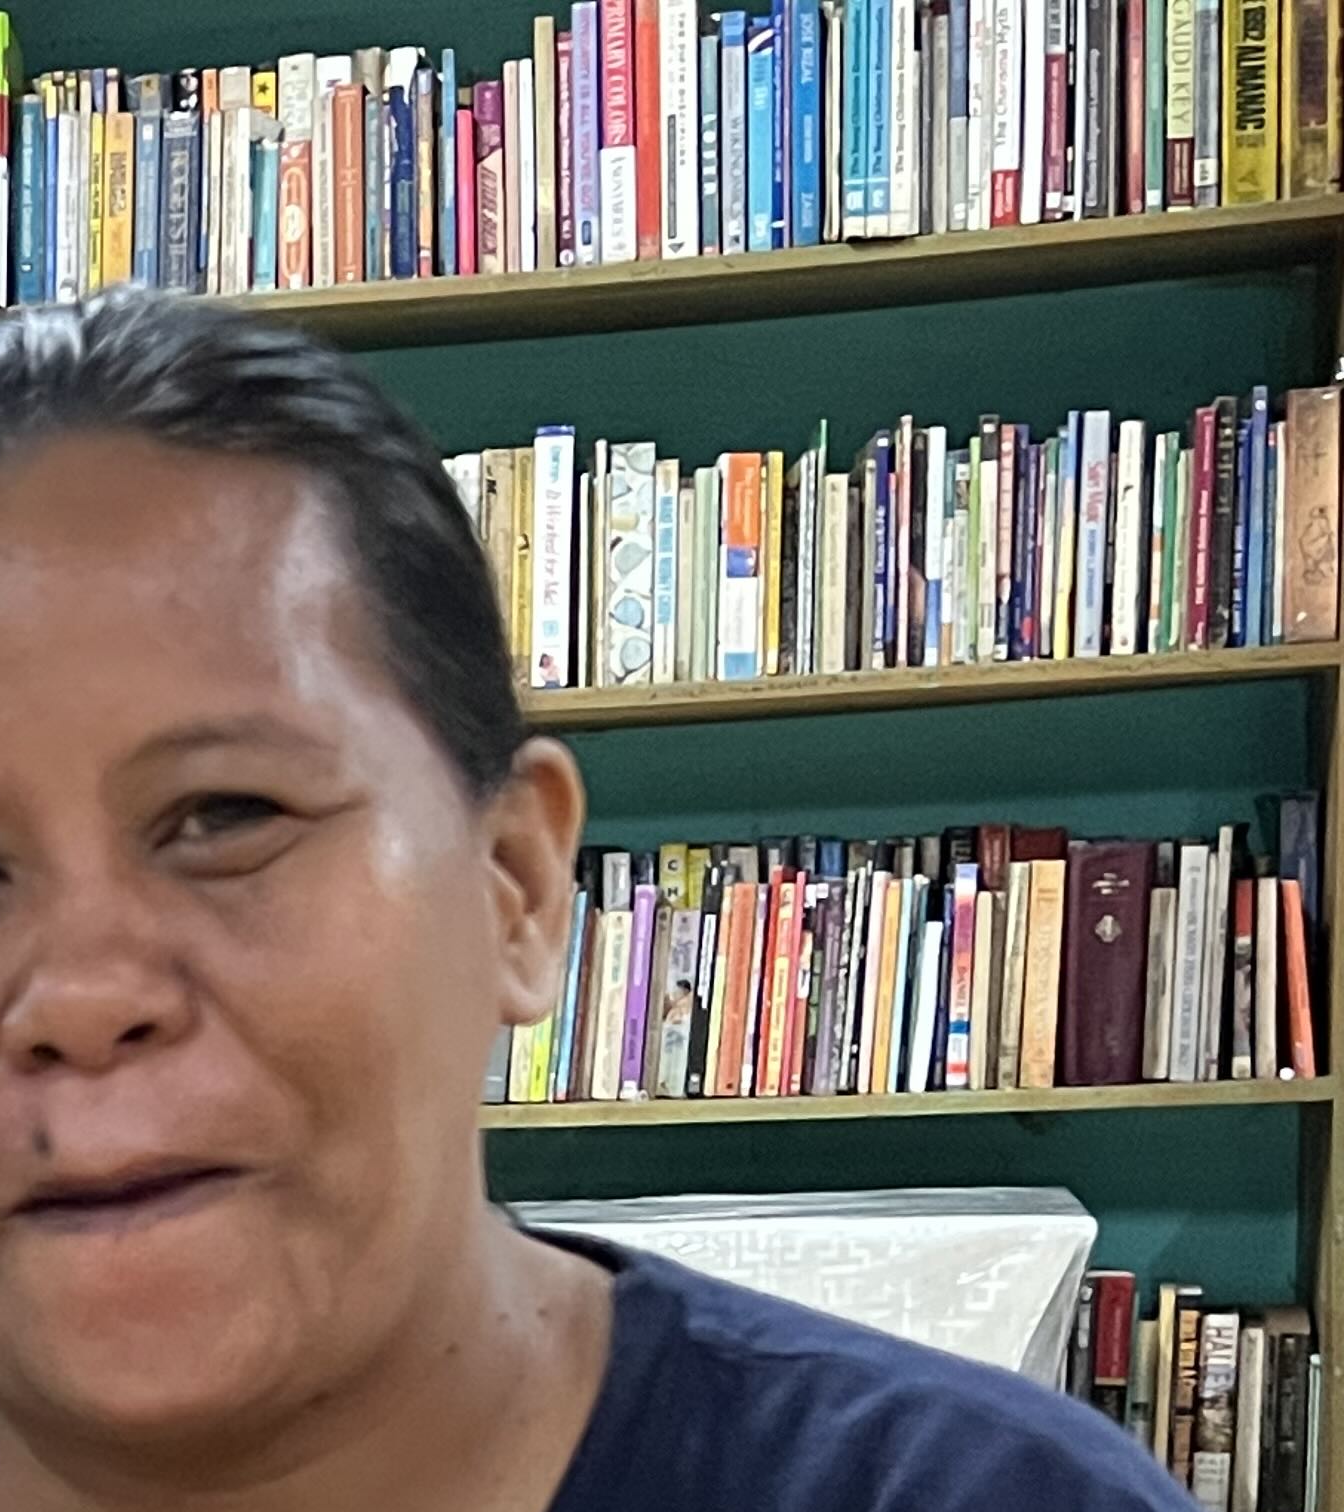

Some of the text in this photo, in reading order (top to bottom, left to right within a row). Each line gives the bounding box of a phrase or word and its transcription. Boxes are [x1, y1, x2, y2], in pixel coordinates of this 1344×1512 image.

[607, 0, 629, 145] PRIMARY COLORS
[800, 14, 814, 85] JOSE RIZAL
[993, 7, 1011, 148] The Charisma Myth
[1172, 0, 1192, 126] GAUDI KEY
[1236, 45, 1267, 132] ALMANAC
[729, 115, 745, 220] WIKINOMICS
